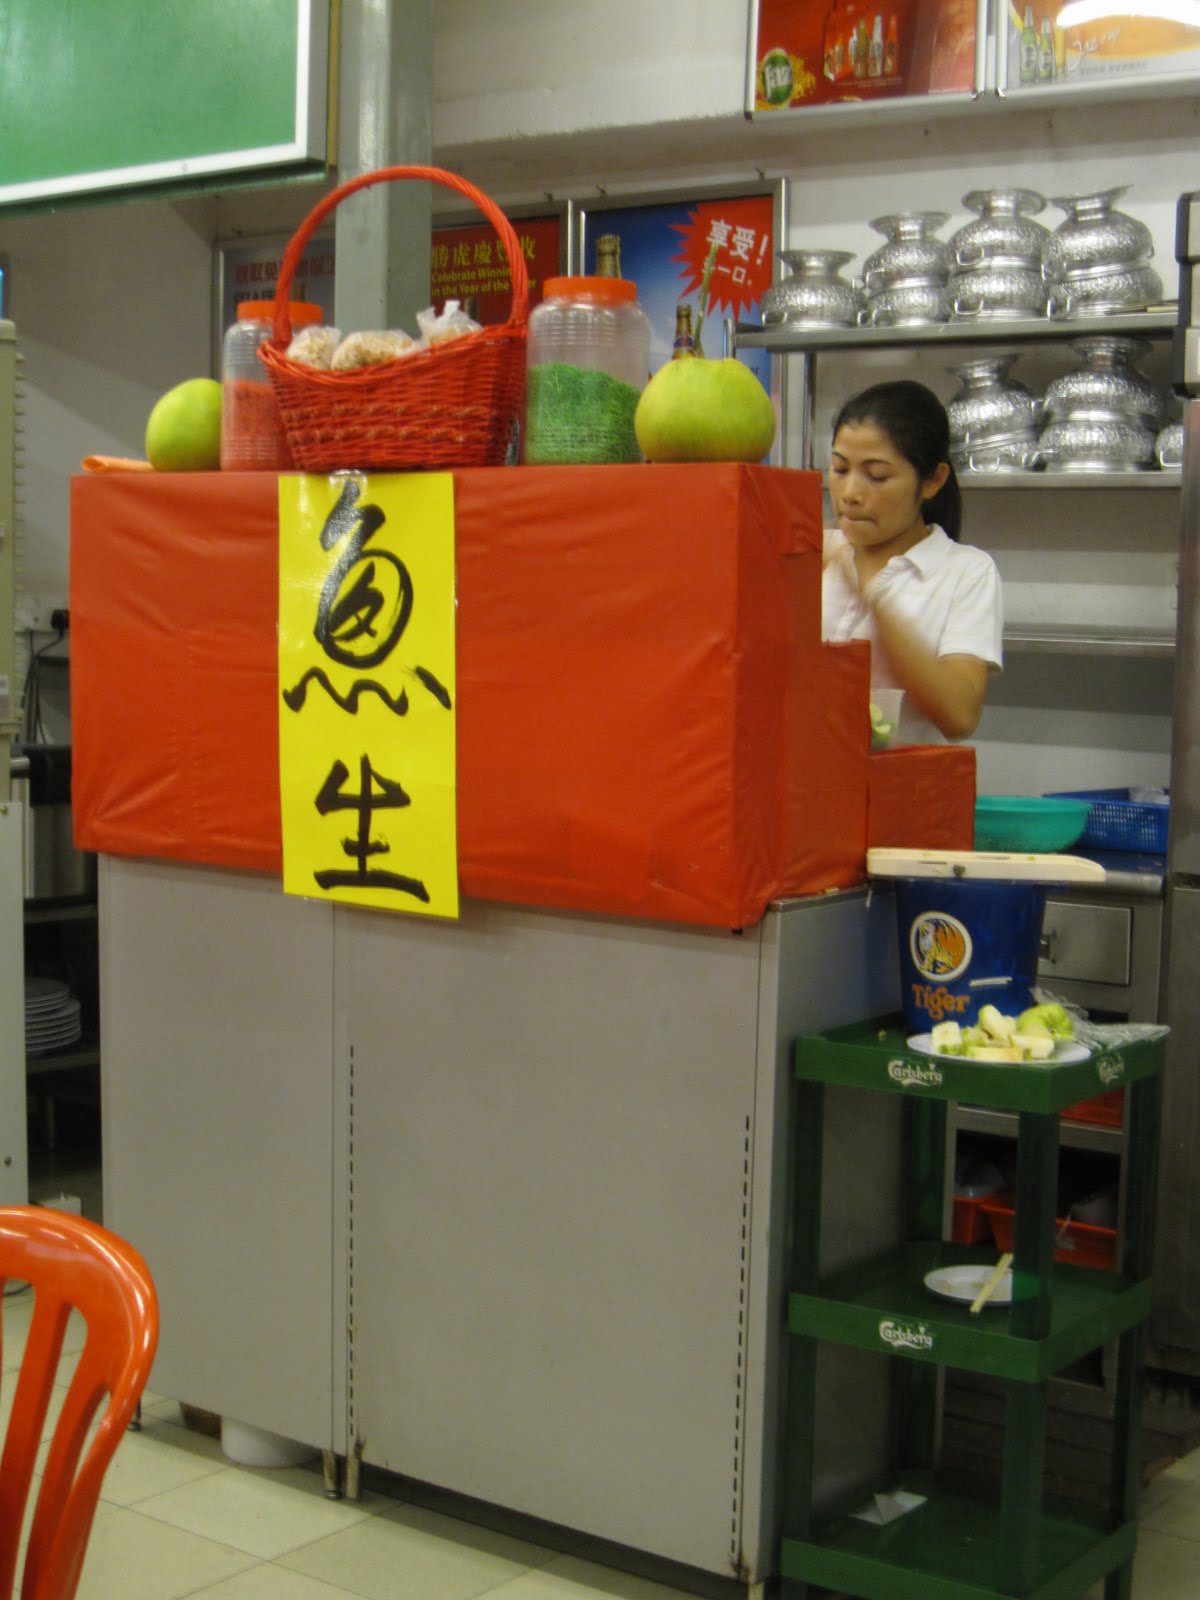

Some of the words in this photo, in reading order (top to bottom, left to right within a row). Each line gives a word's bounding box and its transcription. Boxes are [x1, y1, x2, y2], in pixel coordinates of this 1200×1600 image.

[432, 270, 476, 283] Celebrate
[477, 267, 512, 279] Winnin
[442, 285, 457, 296] the
[460, 283, 478, 294] Year
[481, 281, 491, 292] of
[493, 279, 509, 291] the
[911, 983, 971, 1020] Tiger
[887, 1060, 943, 1088] Carlsberg
[879, 1320, 933, 1350] Carlsberg
